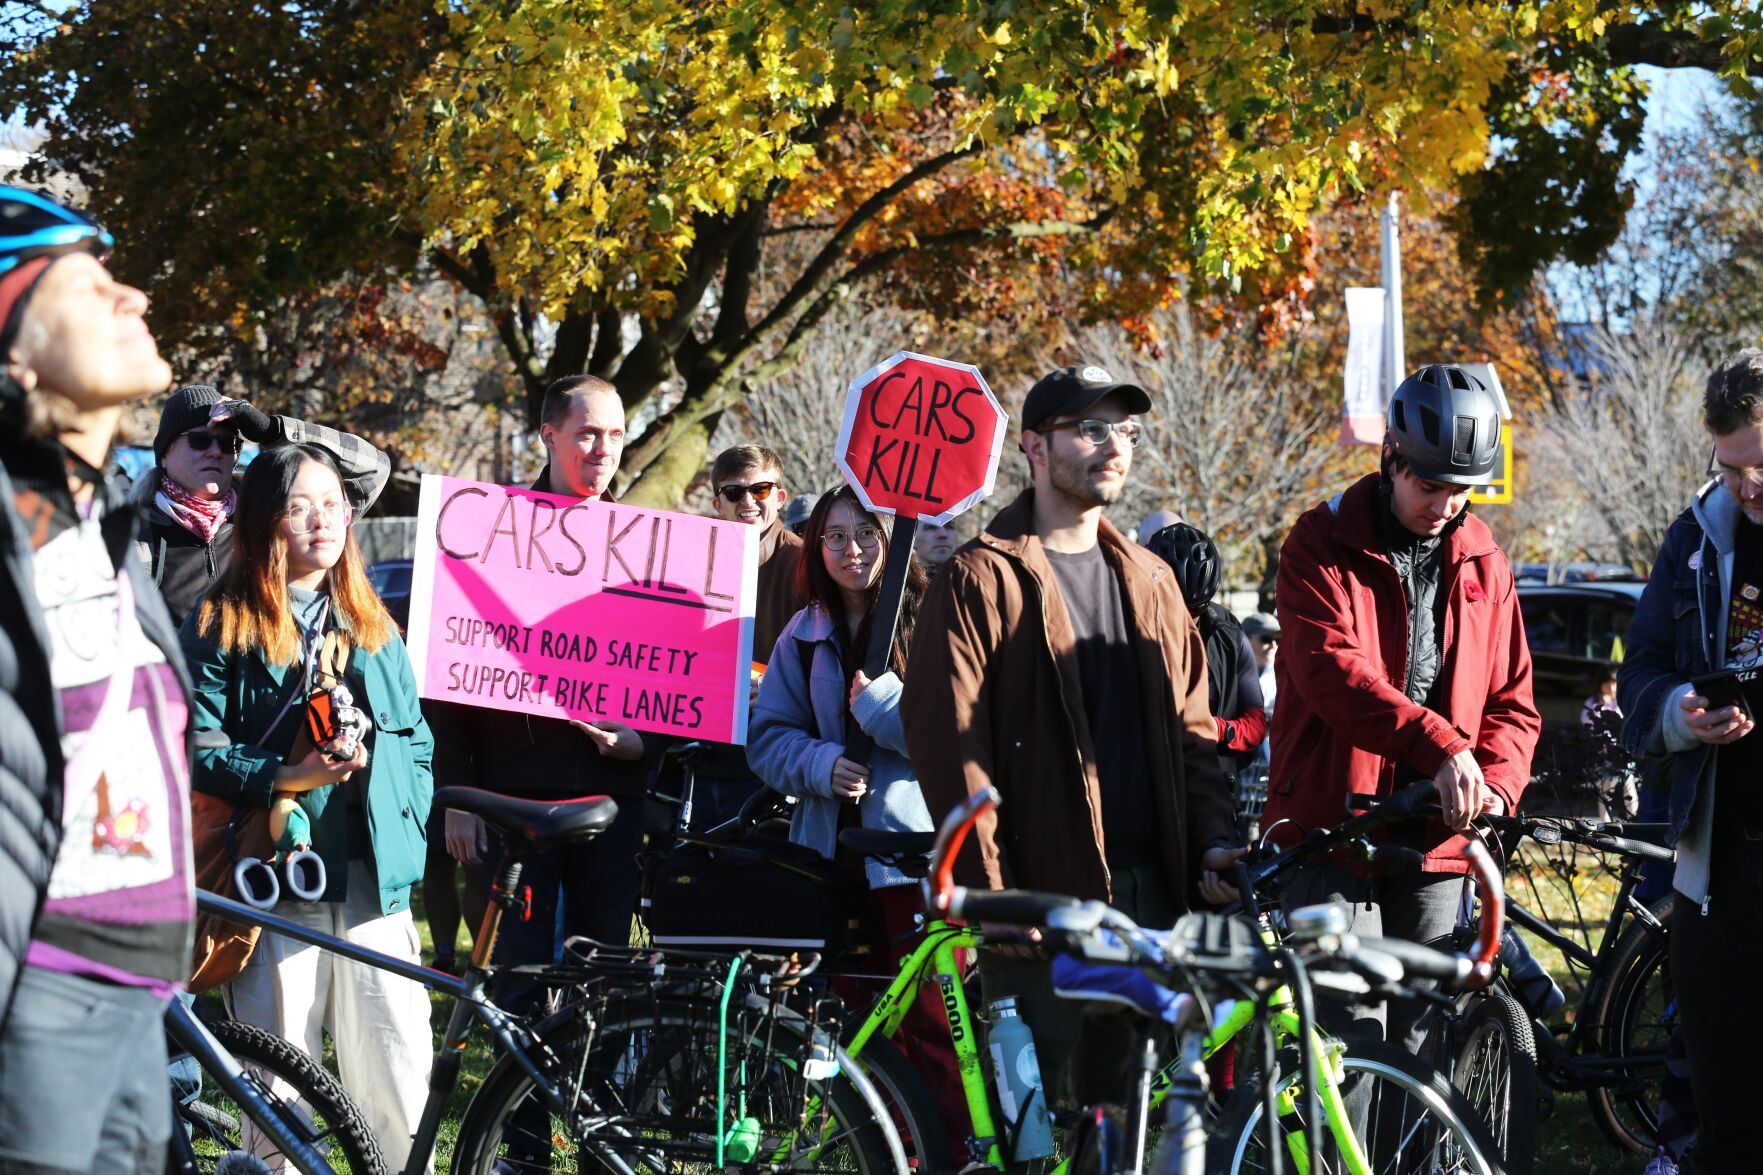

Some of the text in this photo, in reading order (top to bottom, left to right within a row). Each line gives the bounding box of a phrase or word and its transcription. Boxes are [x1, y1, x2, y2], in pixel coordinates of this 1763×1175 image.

[870, 372, 983, 444] CARS
[864, 434, 943, 504] KILL
[435, 487, 734, 601] CARS KILL
[445, 616, 698, 676] SUPPORT ROAD SAFETY
[447, 662, 704, 729] SUPPORT BIKE LANES
[260, 1104, 320, 1169] MARIN
